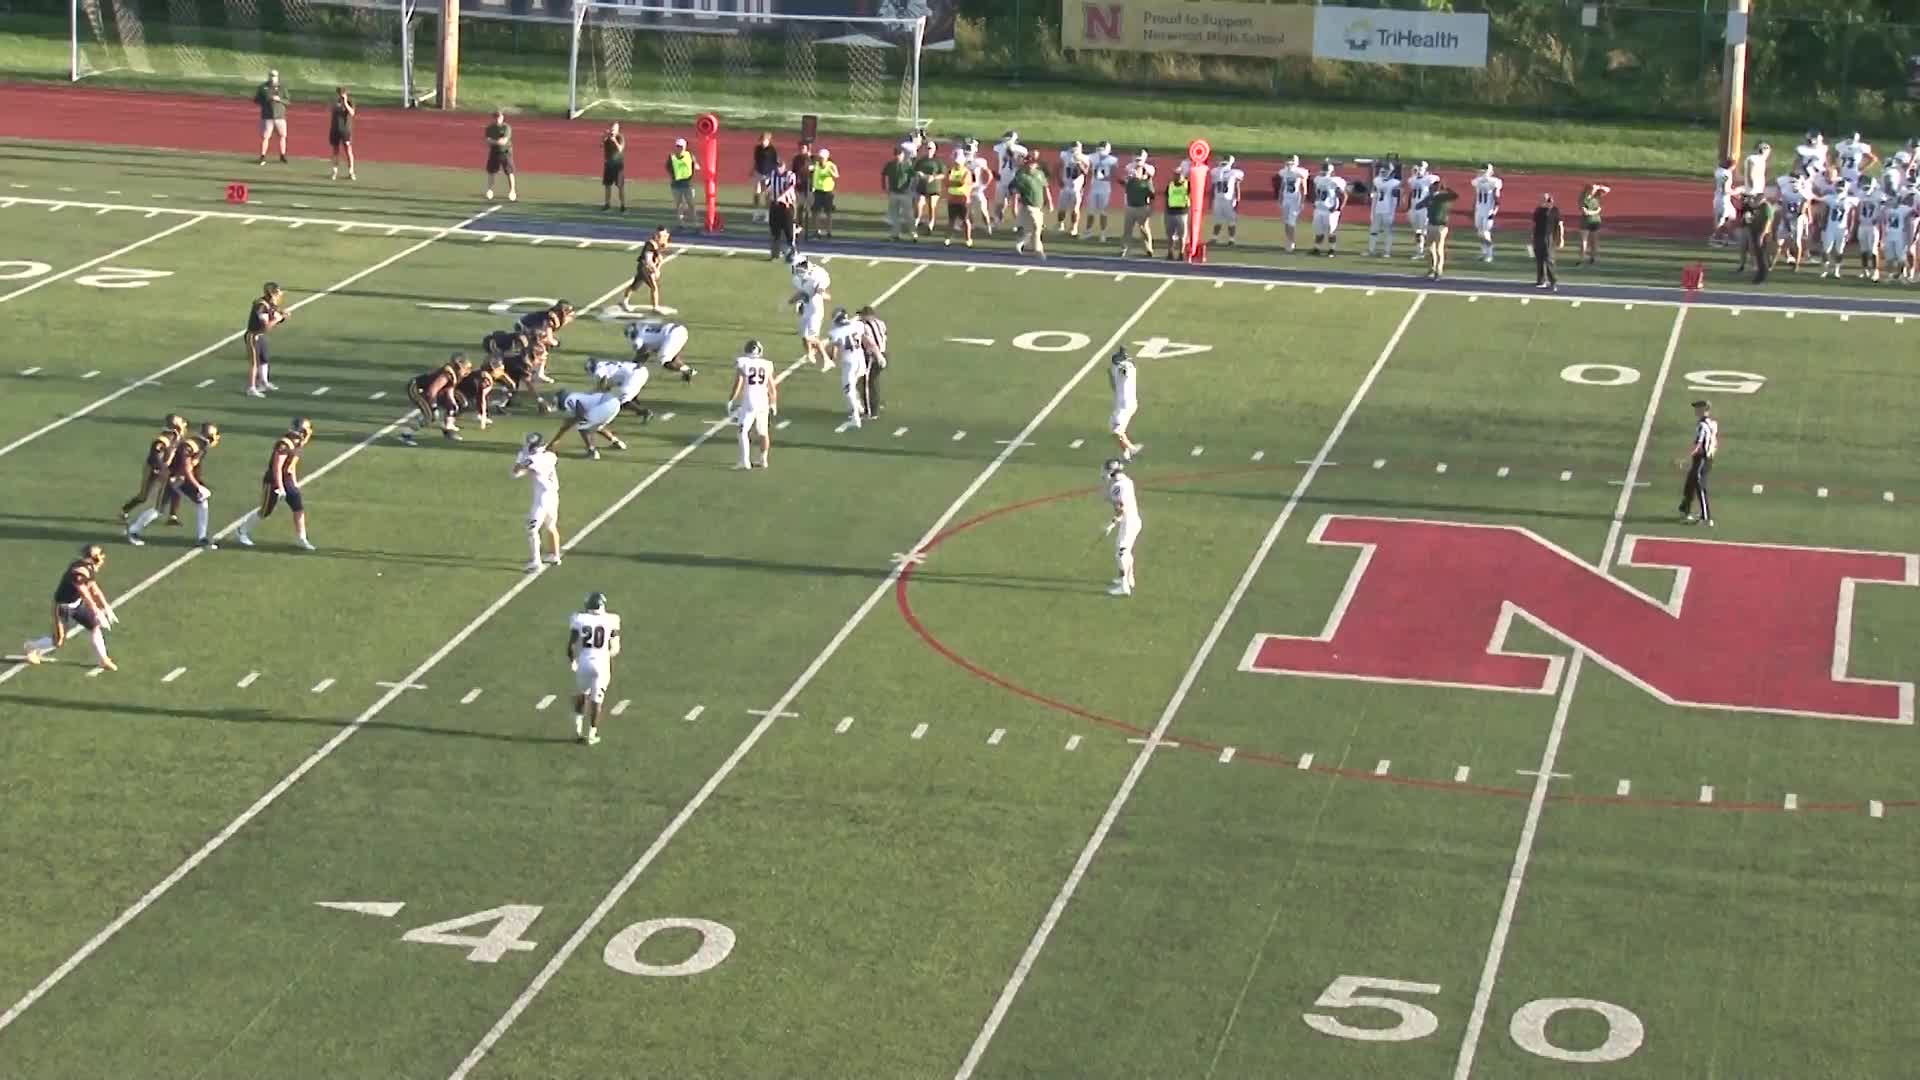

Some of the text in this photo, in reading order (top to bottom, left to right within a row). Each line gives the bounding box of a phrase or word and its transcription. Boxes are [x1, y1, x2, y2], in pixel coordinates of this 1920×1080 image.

[1376, 29, 1459, 49] TriHealth
[227, 184, 245, 200] 20
[747, 366, 766, 385] 29
[1237, 514, 1920, 725] N
[581, 625, 605, 649] 20
